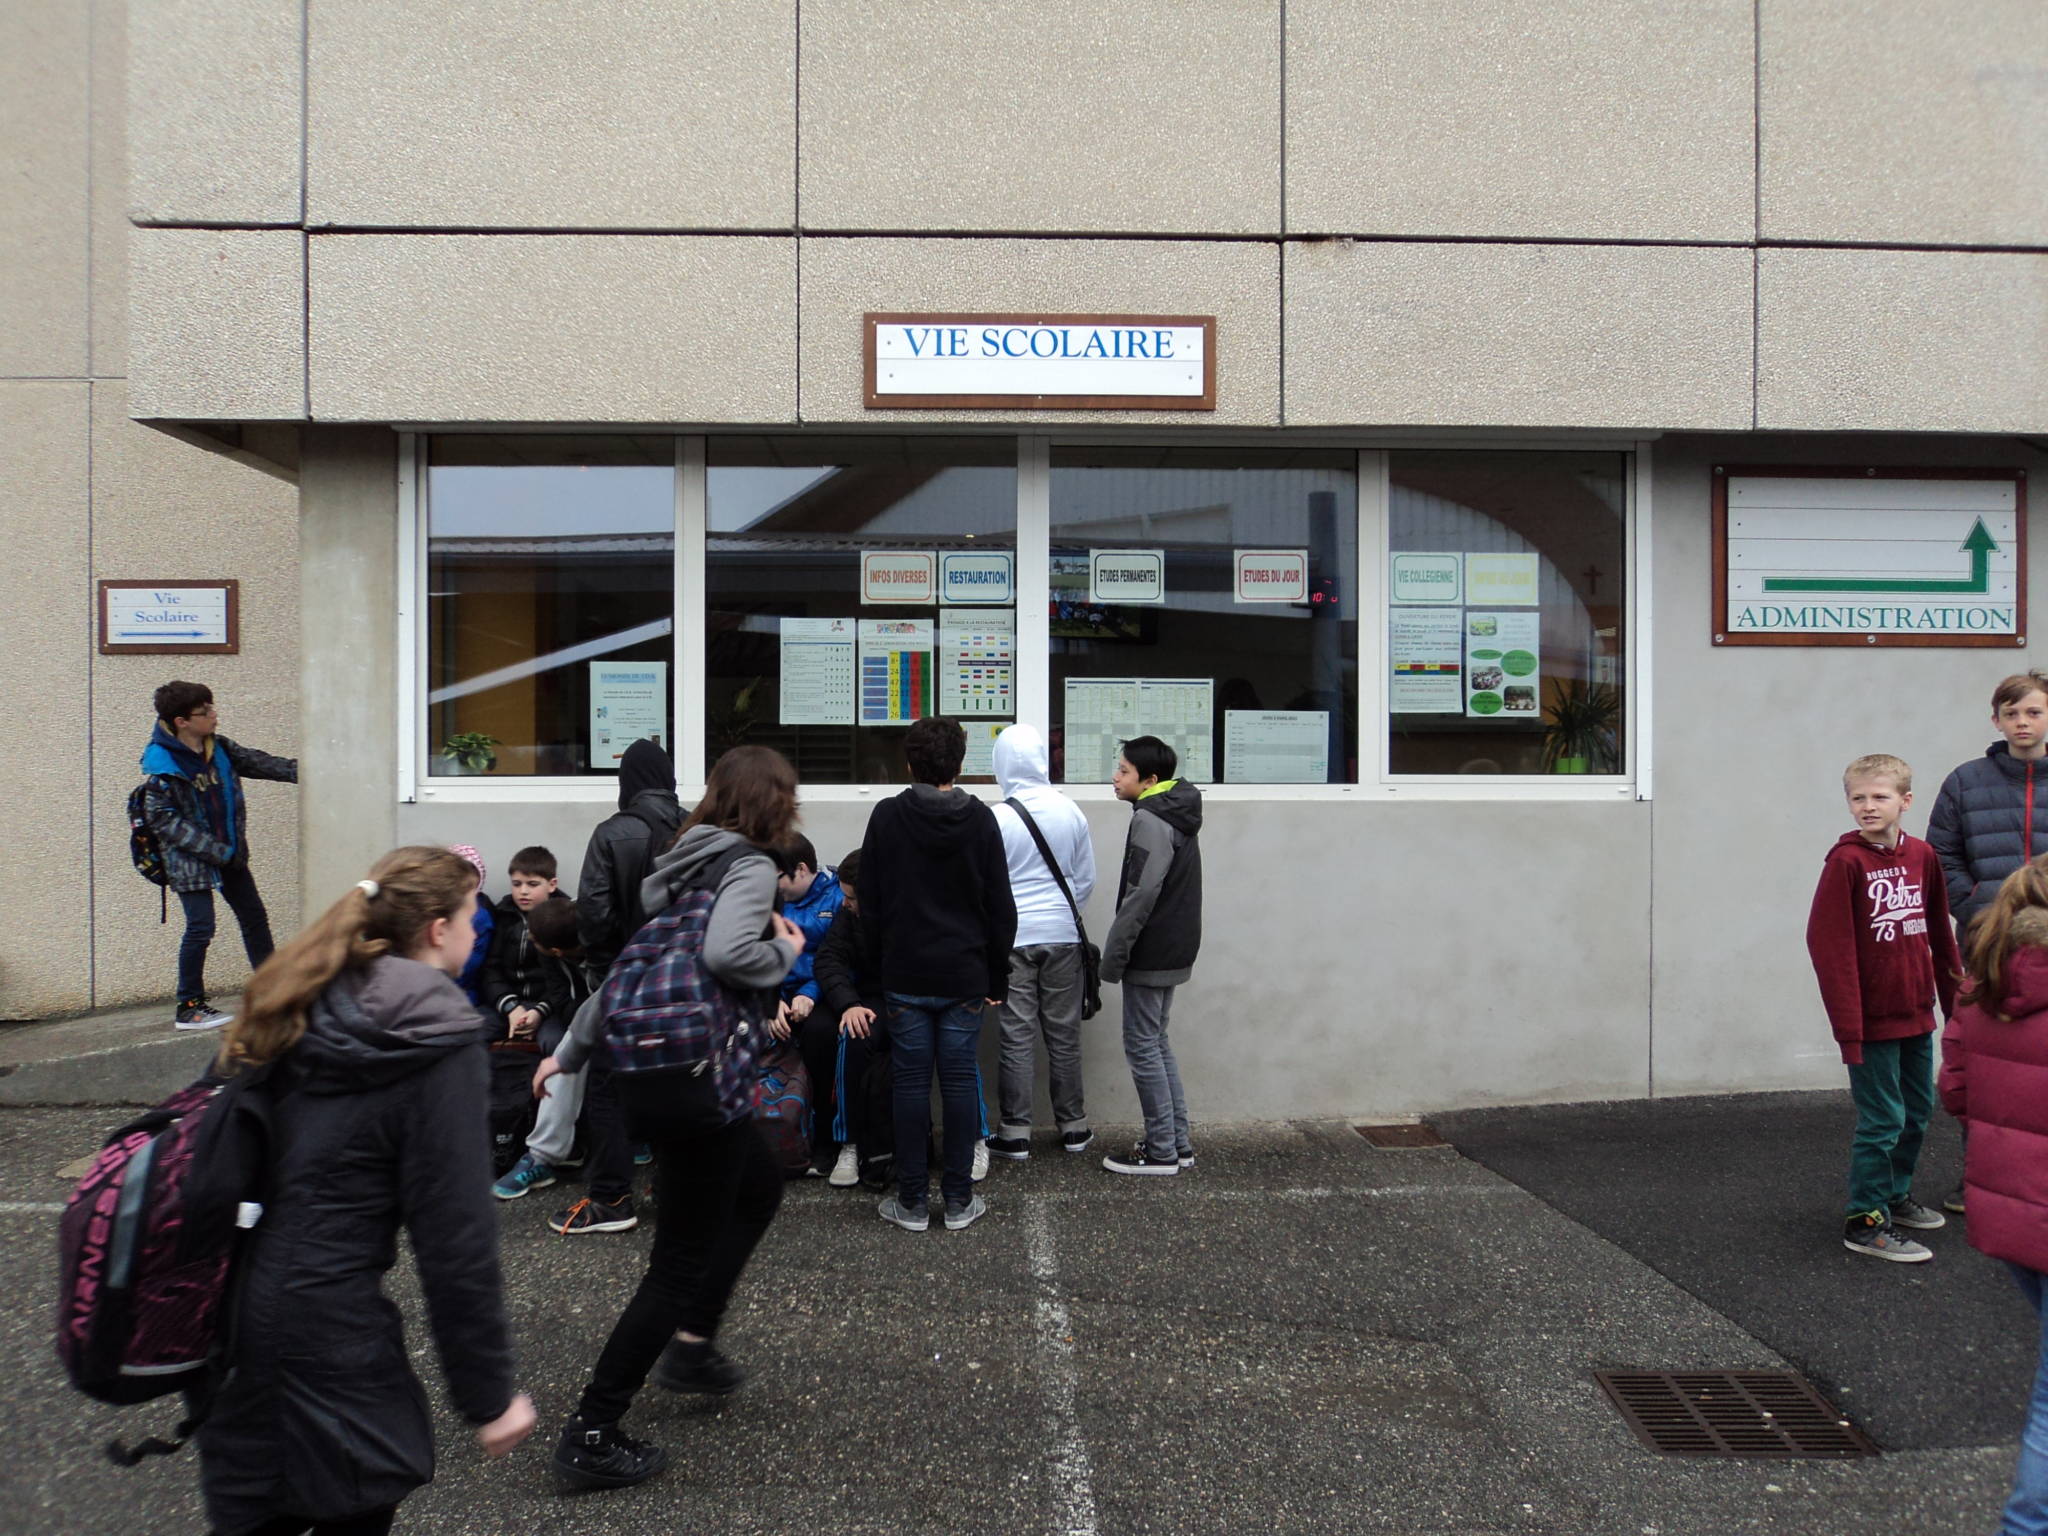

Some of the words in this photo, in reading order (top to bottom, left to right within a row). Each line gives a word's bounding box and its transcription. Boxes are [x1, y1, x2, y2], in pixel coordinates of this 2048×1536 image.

[903, 327, 969, 357] VIE
[982, 328, 1174, 359] SCOLAIRE
[870, 570, 892, 583] INFOS
[893, 570, 927, 584] DIVERSES
[949, 570, 1006, 585] RESTAURATION
[1099, 569, 1120, 583] ETUDES
[1120, 569, 1157, 583] PERMANENTES
[1244, 570, 1270, 583] ETUDES
[1271, 570, 1281, 583] DU
[1282, 570, 1300, 583] JOUR
[1398, 570, 1409, 583] VIE
[1410, 570, 1454, 583] COLLEGIENNE
[154, 592, 181, 605] Vie
[135, 610, 199, 623] Scolaire
[1737, 606, 2012, 630] ADMINISTRATION
[1866, 867, 1900, 881] RUGGED
[1867, 876, 1924, 917] Petro
